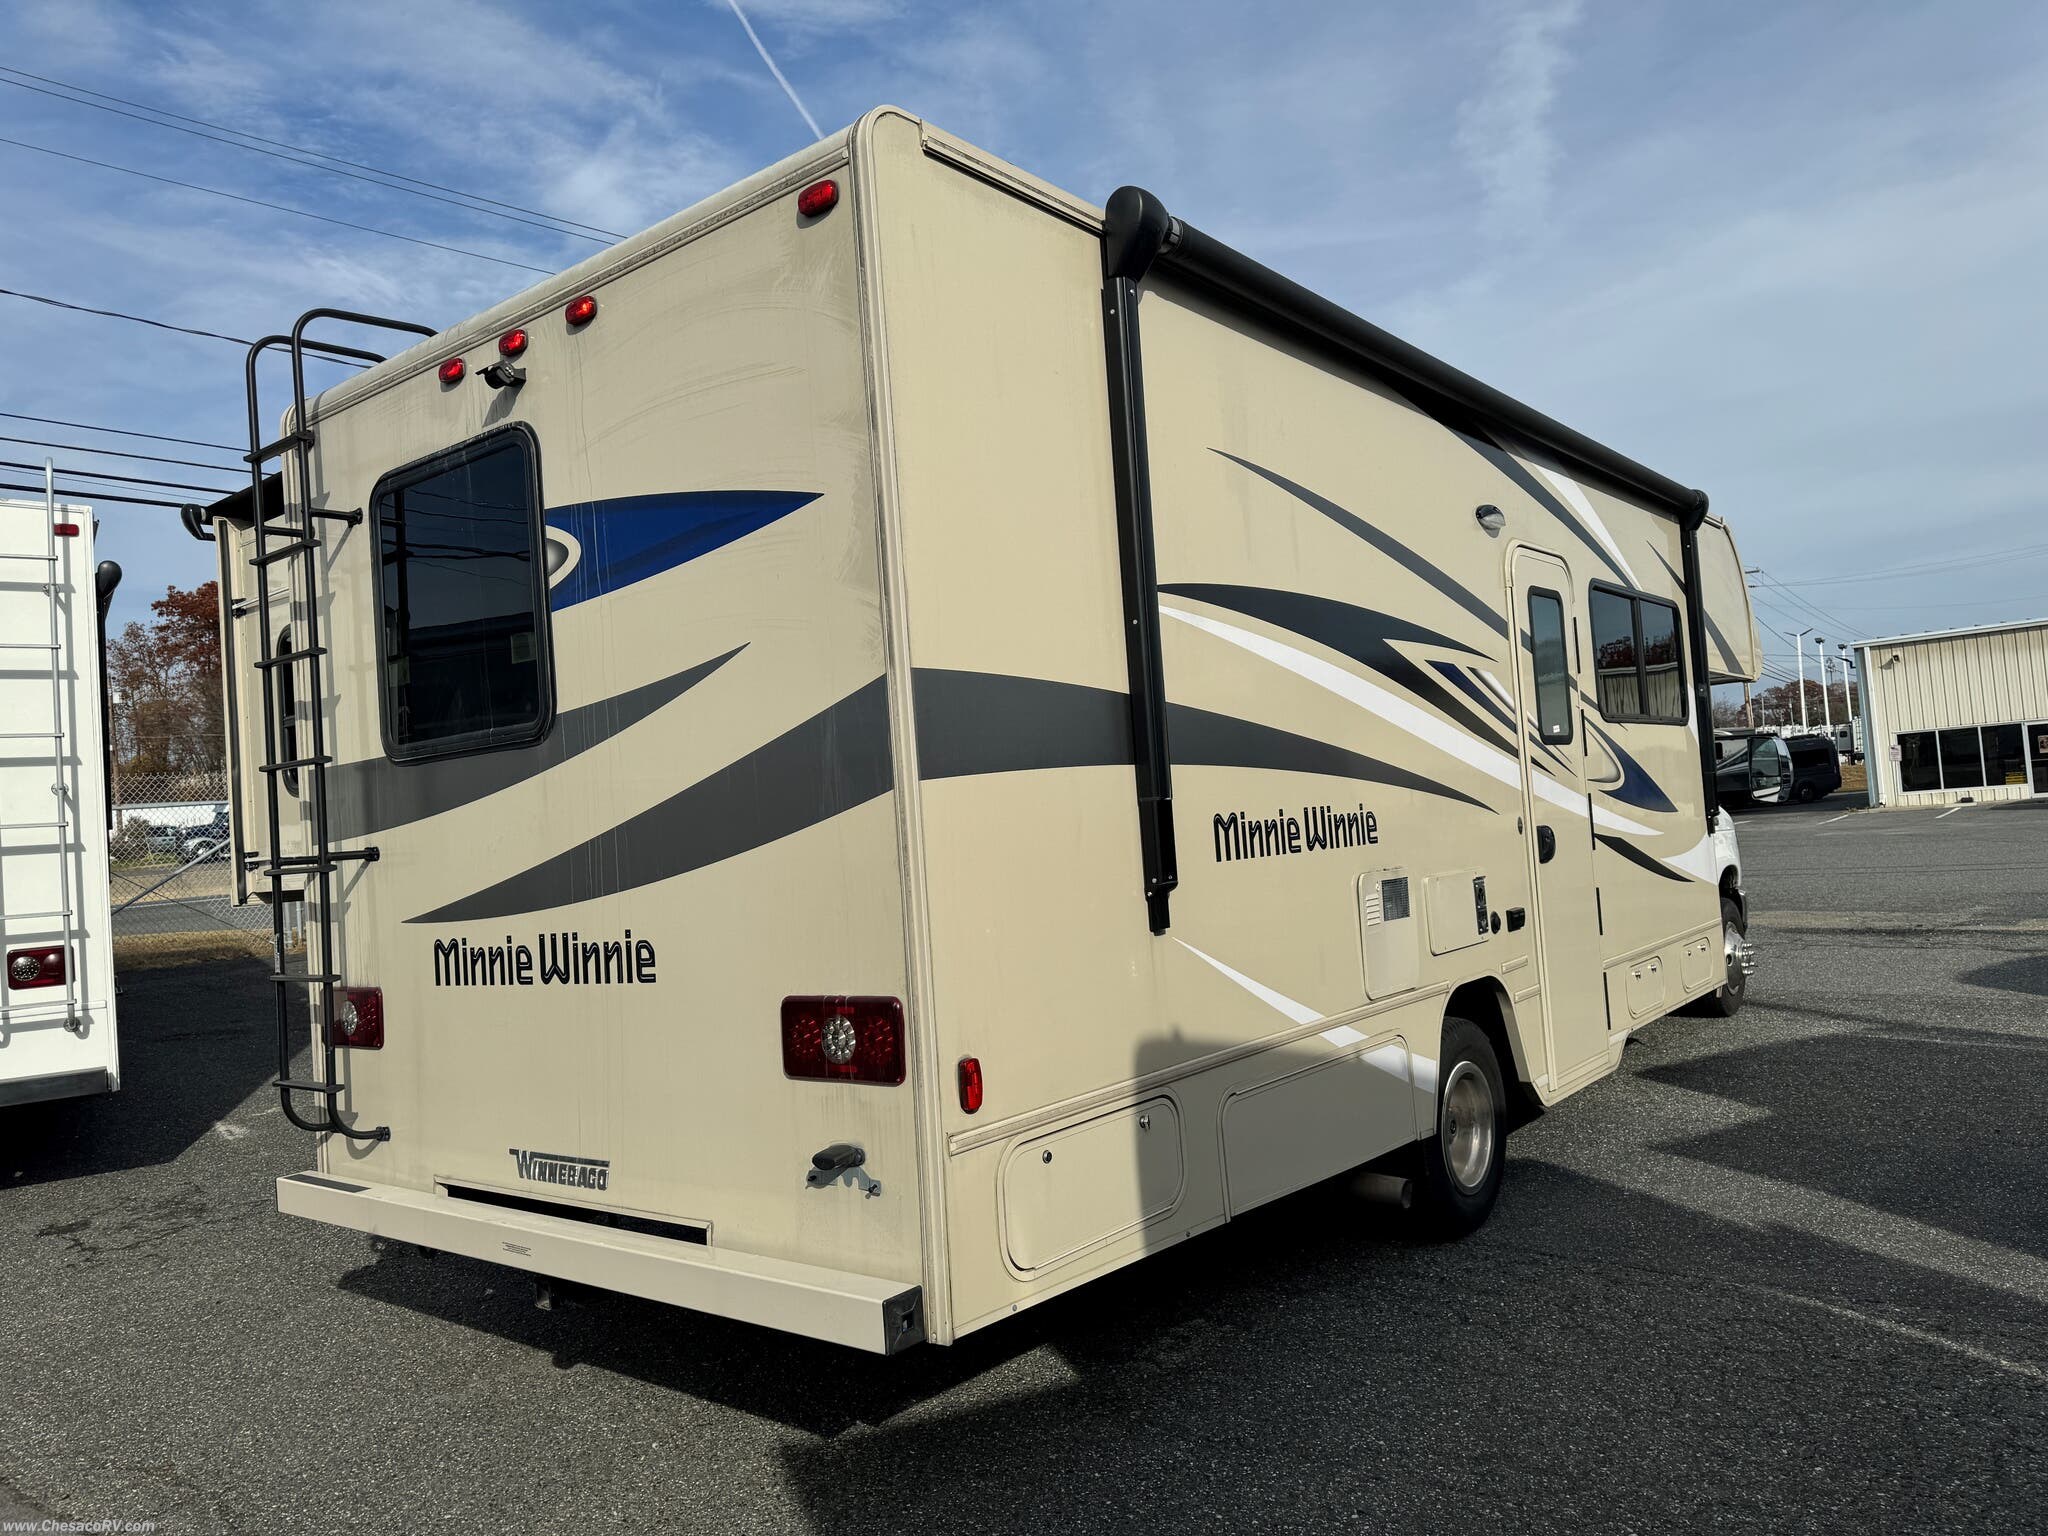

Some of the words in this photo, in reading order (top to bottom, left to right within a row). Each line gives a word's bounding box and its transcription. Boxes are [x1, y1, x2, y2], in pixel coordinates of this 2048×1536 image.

[1213, 808, 1302, 863] Minnie
[1303, 803, 1379, 852] Winnie
[434, 935, 534, 986] Minnie
[538, 929, 657, 985] Winnie
[508, 1148, 610, 1191] WINNEBAGO
